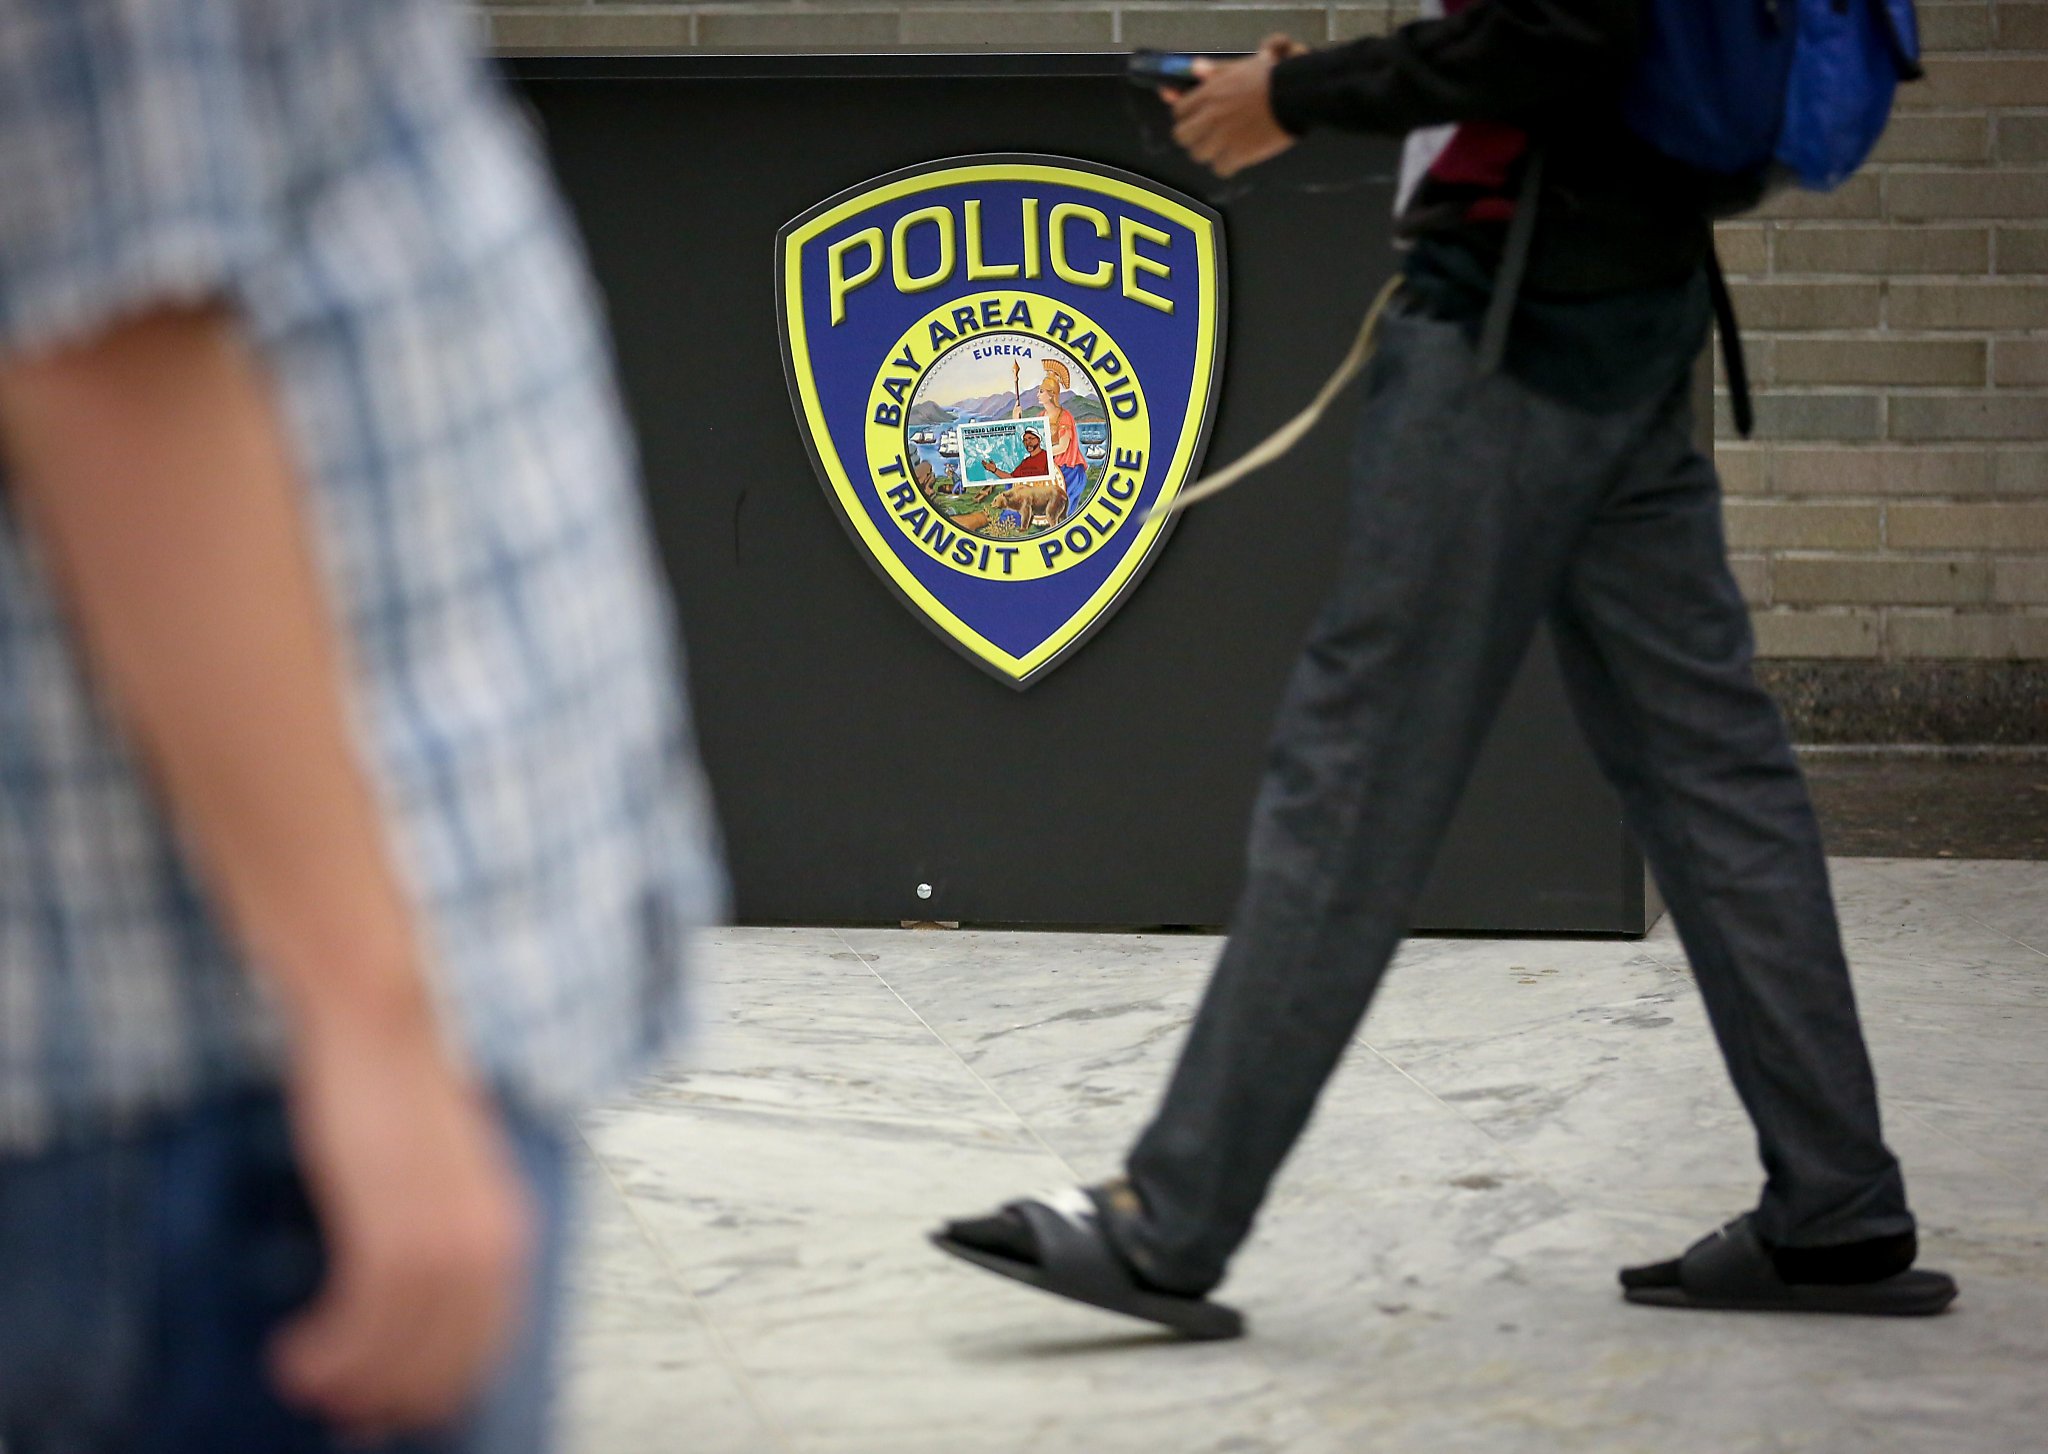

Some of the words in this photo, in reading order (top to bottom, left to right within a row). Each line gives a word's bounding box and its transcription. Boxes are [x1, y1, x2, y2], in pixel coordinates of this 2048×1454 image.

[828, 197, 1175, 327] POLICE
[874, 343, 922, 428] BAY
[928, 299, 1034, 351] AREA
[1046, 309, 1140, 421] RAPID
[973, 344, 1032, 360] EUREKA
[877, 454, 1019, 574] TRANSIT
[1038, 447, 1142, 569] POLICE
